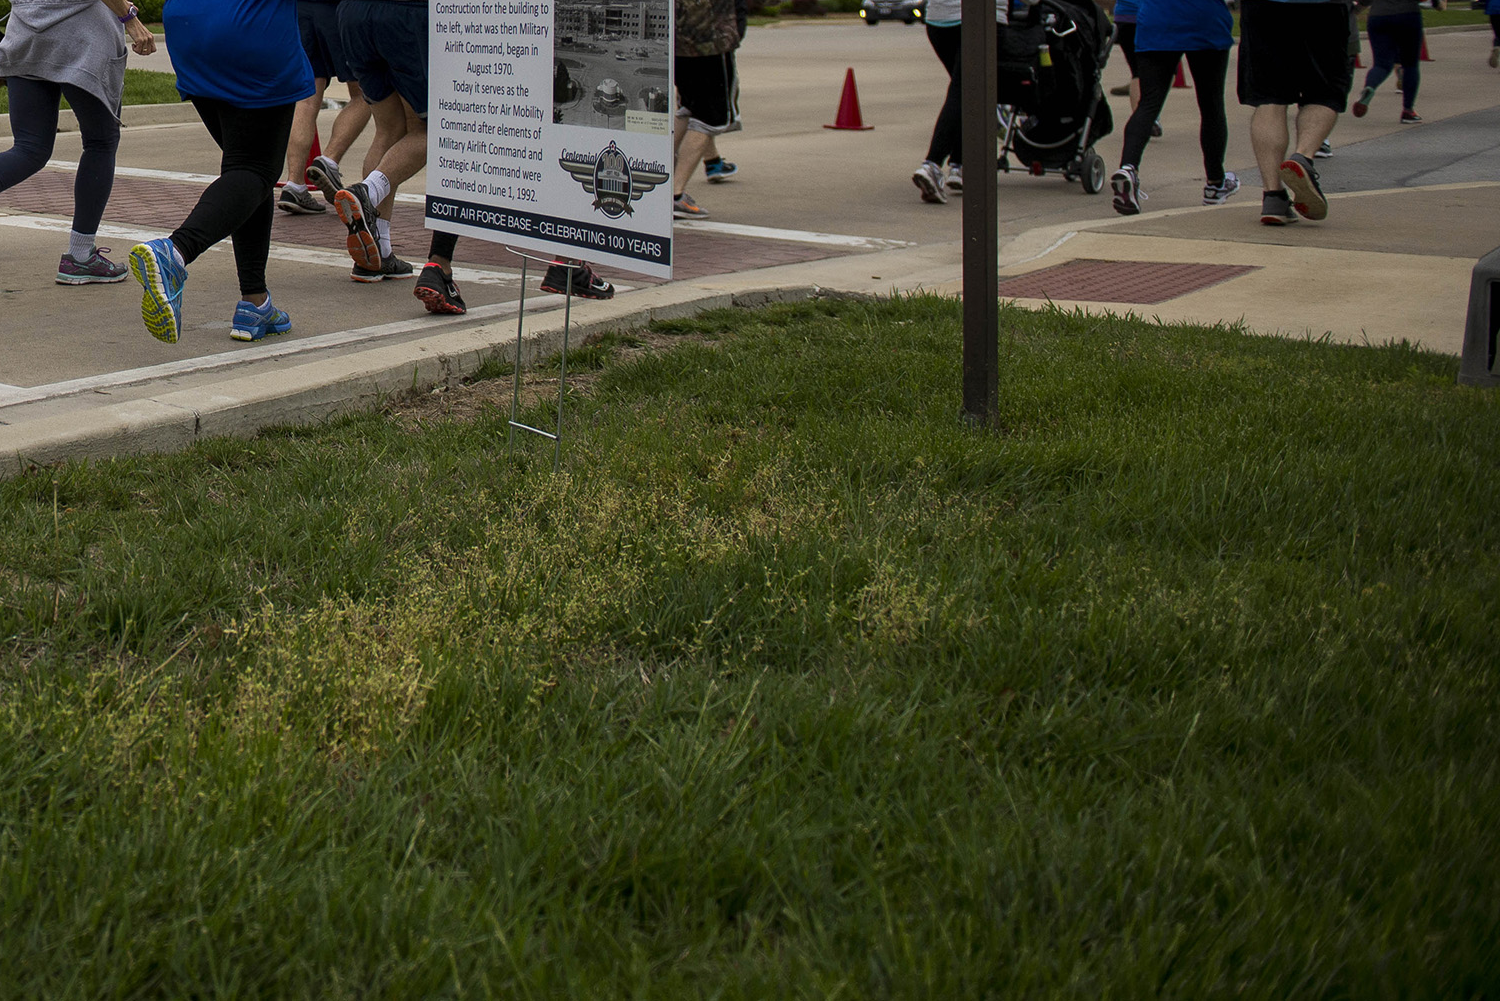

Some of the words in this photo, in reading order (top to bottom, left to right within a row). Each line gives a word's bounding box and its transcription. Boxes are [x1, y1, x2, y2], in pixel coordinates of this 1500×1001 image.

[435, 2, 480, 14] Construction
[482, 1, 493, 14] for
[494, 1, 507, 14] the
[508, 1, 539, 17] building
[540, 2, 549, 15] to
[436, 21, 447, 33] the
[449, 21, 463, 35] left,
[464, 21, 483, 34] what
[484, 25, 498, 34] was
[500, 22, 518, 35] then
[519, 22, 549, 38] Military
[444, 40, 464, 53] Airlift
[465, 41, 505, 57] Command,
[506, 42, 530, 58] began
[531, 43, 539, 56] in
[466, 61, 492, 76] August
[493, 63, 514, 75] 1970.
[452, 80, 473, 95] Today
[474, 81, 480, 93] it
[481, 84, 505, 95] serves
[506, 86, 515, 96] as
[516, 84, 529, 97] the
[438, 98, 486, 114] Headquarters
[488, 101, 498, 115] for
[500, 104, 511, 116] Air
[512, 104, 544, 122] Mobility
[440, 118, 476, 133] Command
[478, 121, 496, 135] after
[497, 123, 532, 139] elements
[533, 127, 542, 140] of
[438, 137, 466, 154] Military
[466, 140, 487, 154] Airlift
[488, 143, 526, 159] Command
[528, 148, 543, 161] and
[561, 148, 598, 165] Centennial
[601, 152, 624, 171] 100
[628, 156, 666, 173] Celebration
[438, 156, 469, 173] Strategic
[470, 161, 481, 173] Air
[482, 162, 521, 179] Command
[522, 170, 542, 182] were
[441, 178, 476, 192] combined
[477, 183, 487, 194] on
[488, 183, 506, 197] June
[508, 186, 515, 200] 1,
[516, 187, 538, 203] 1992.
[431, 202, 459, 217] SCOTT
[460, 207, 475, 221] AIR
[476, 210, 506, 227] FORCE
[507, 215, 532, 232] BASE
[539, 221, 605, 246] CELEBRATING
[608, 235, 625, 249] 100
[627, 237, 661, 257] YEARS
